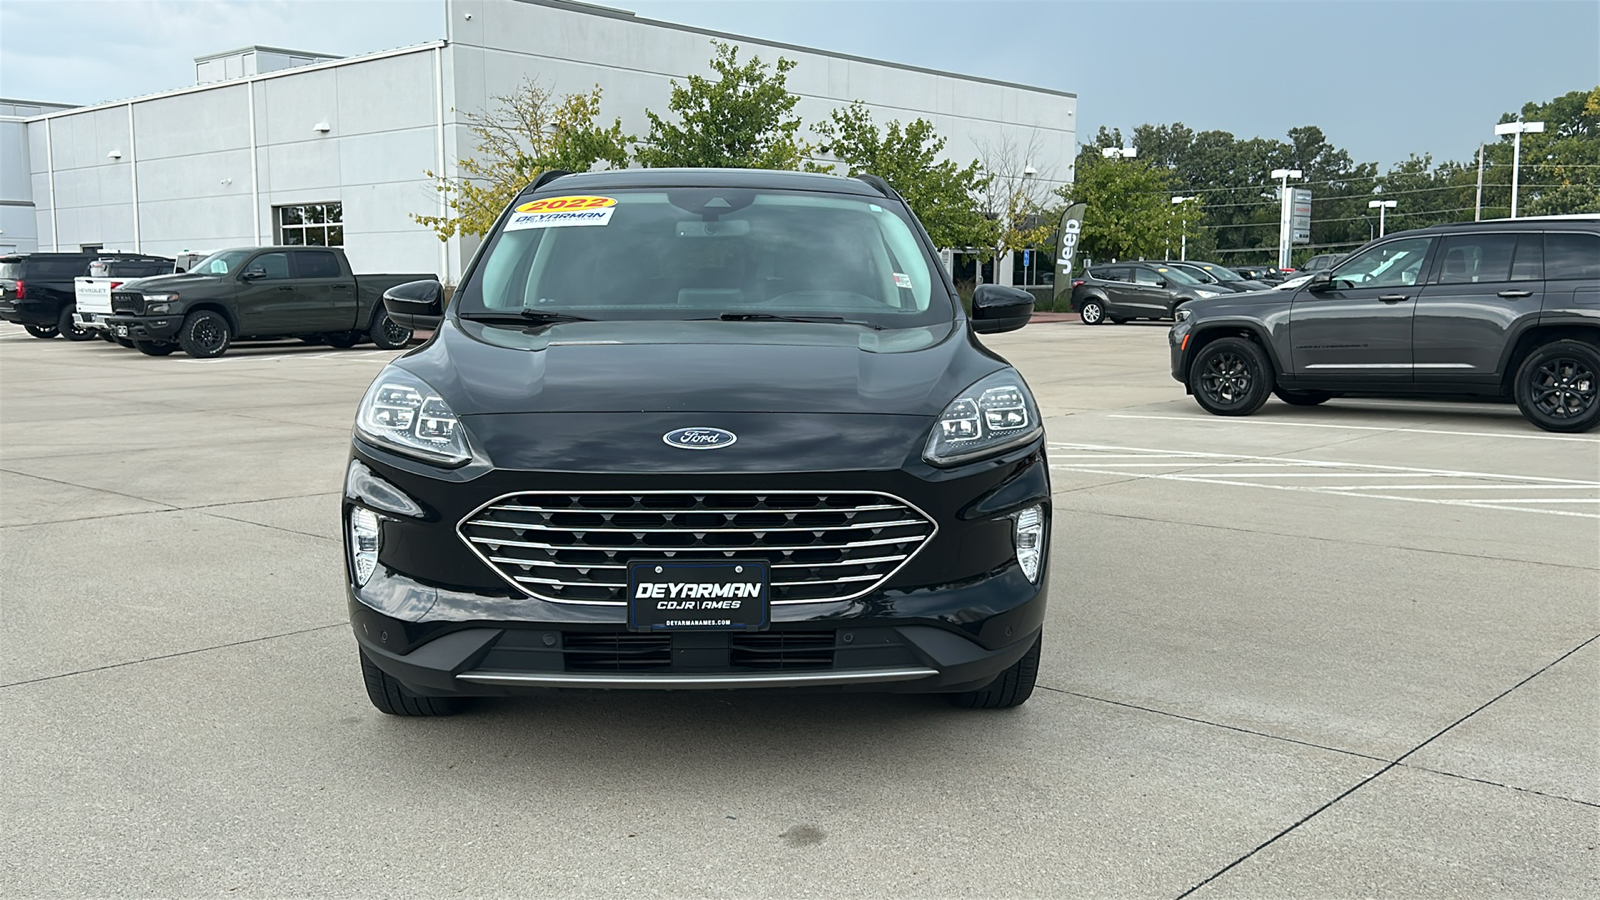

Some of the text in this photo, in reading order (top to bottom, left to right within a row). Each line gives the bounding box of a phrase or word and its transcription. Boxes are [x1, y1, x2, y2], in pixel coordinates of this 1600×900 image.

[524, 198, 609, 212] 2022
[515, 212, 607, 223] DEYARMAN
[1057, 218, 1081, 275] Jeep
[680, 430, 720, 443] Ford
[635, 582, 762, 599] DEYARMAN
[656, 600, 742, 610] CDJR AMES
